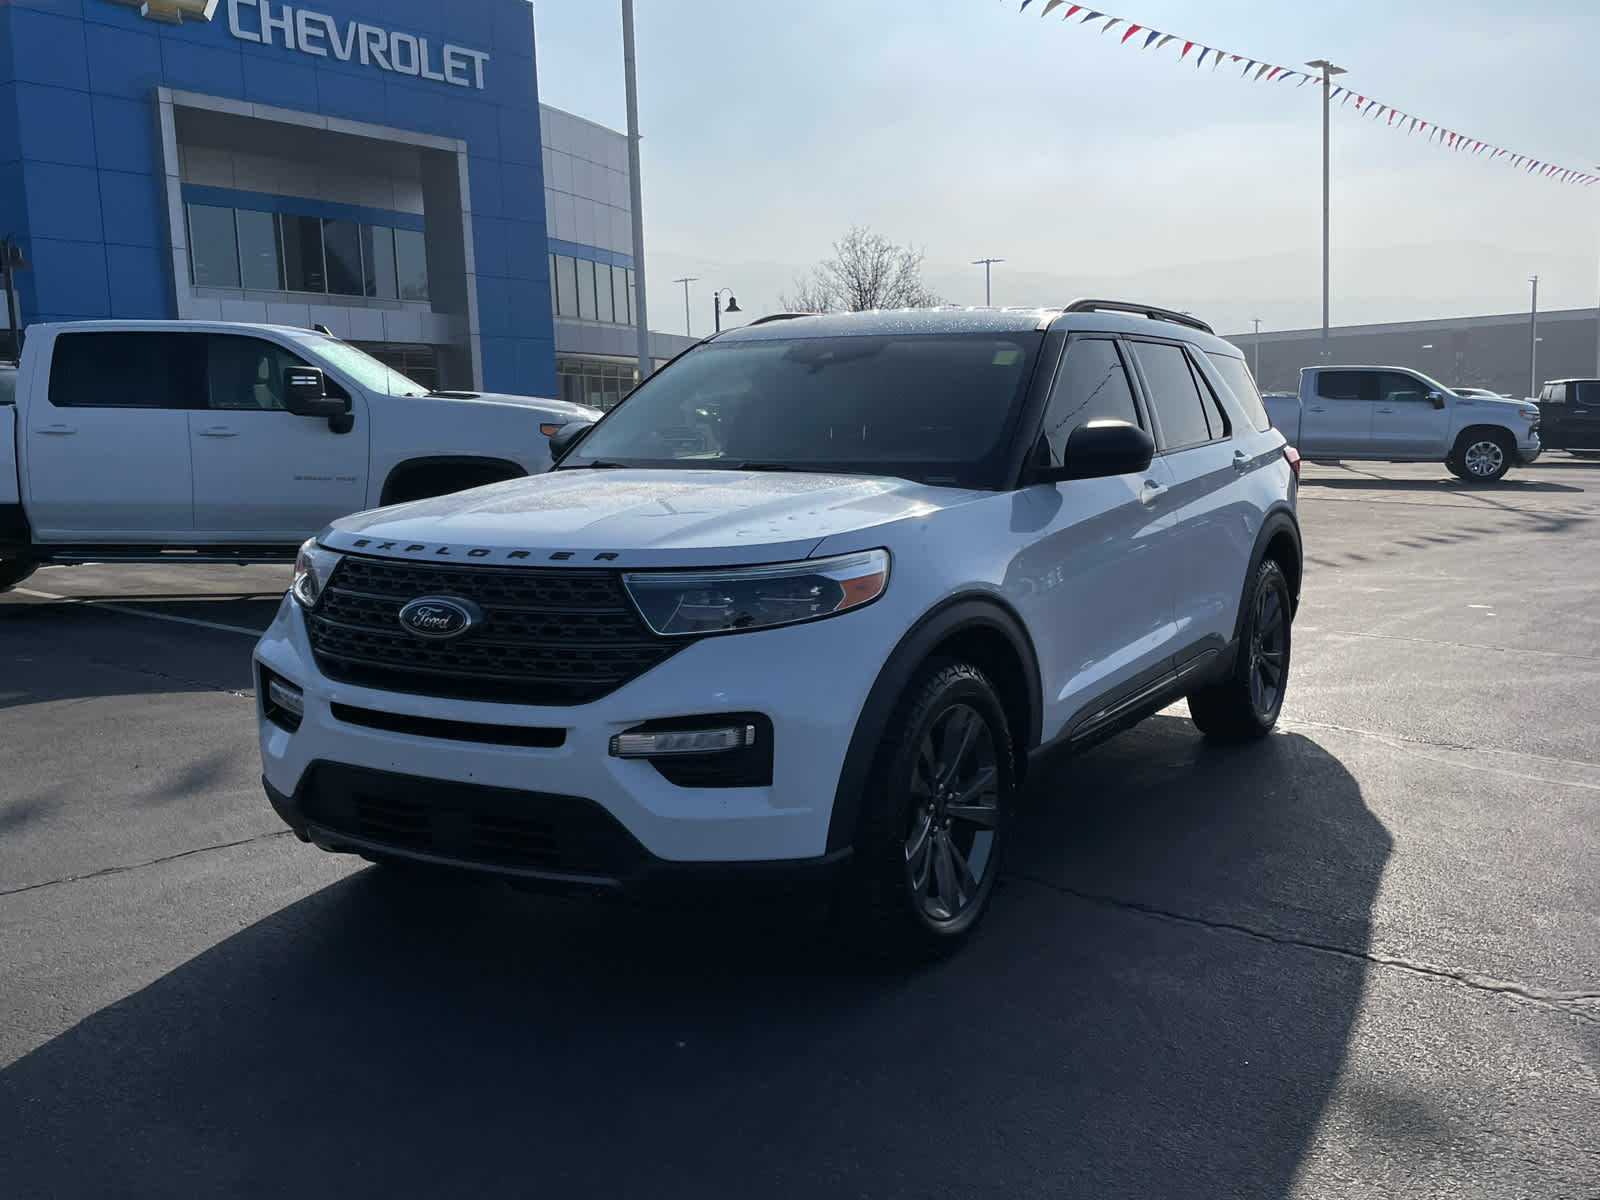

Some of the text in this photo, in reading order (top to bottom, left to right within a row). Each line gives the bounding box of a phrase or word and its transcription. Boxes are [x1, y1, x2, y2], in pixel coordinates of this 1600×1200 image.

[227, 0, 490, 90] CHEVROLET
[352, 538, 620, 561] EXPLORER
[412, 606, 453, 629] Ford
